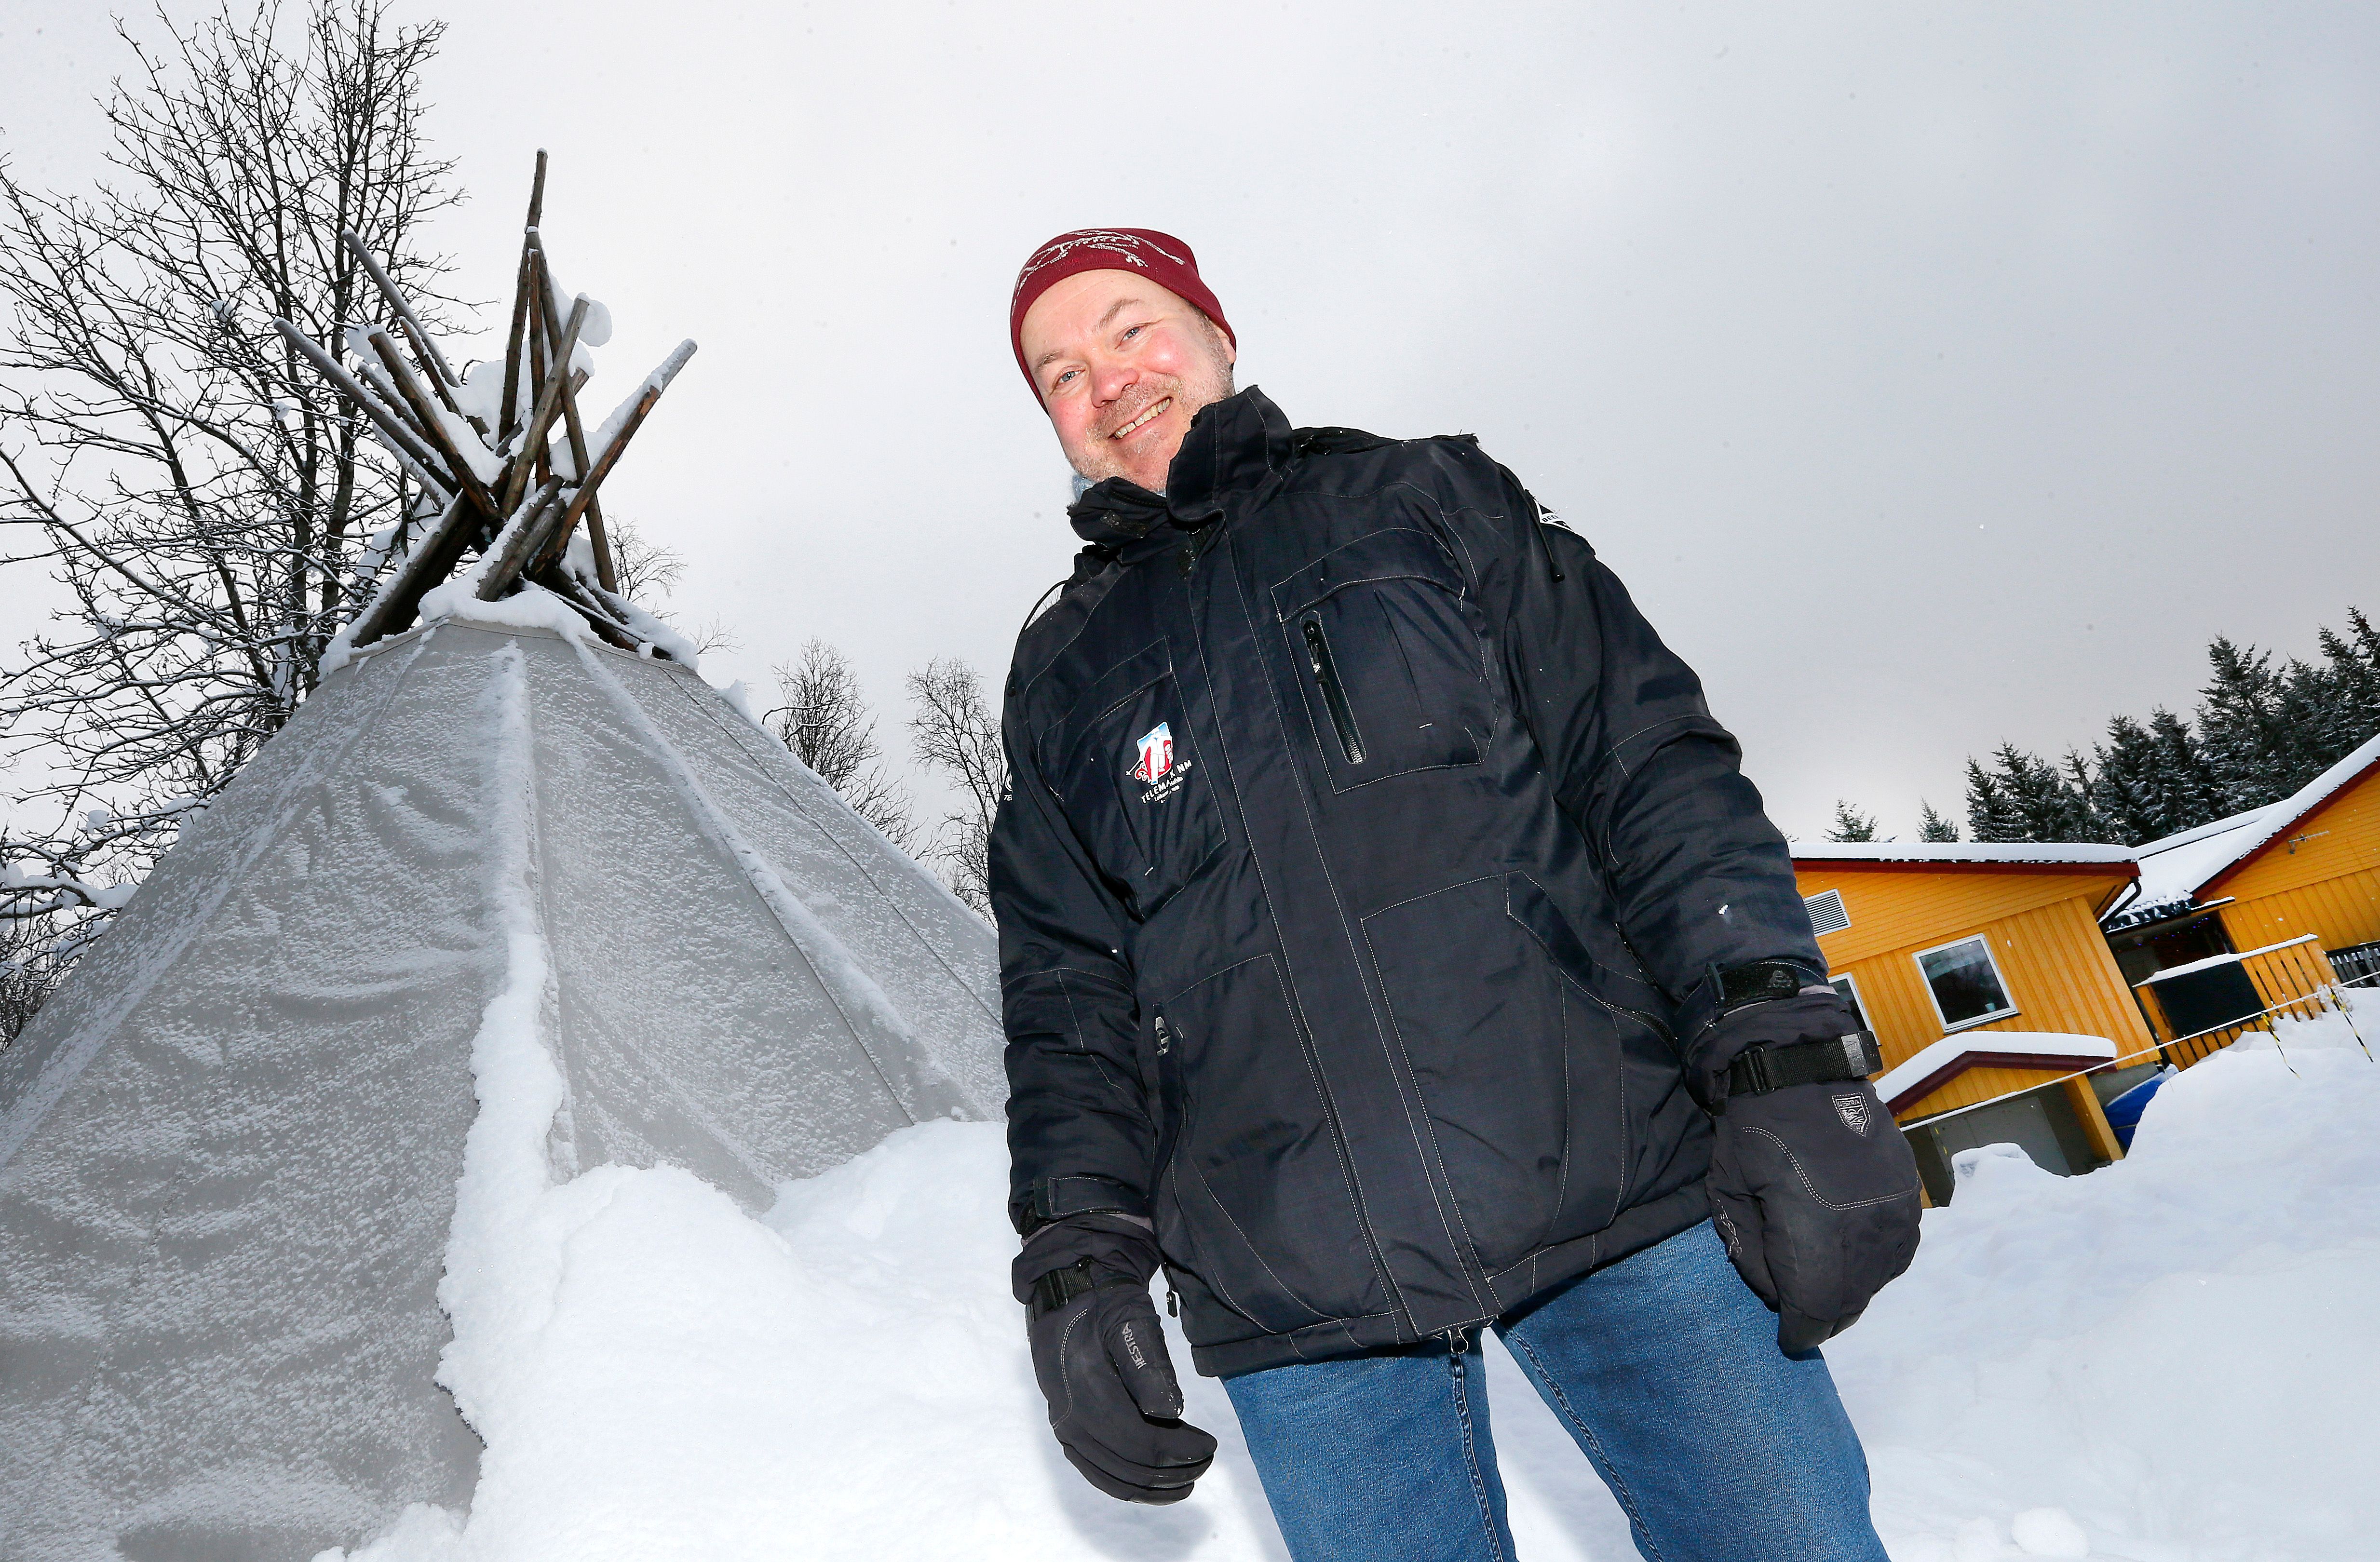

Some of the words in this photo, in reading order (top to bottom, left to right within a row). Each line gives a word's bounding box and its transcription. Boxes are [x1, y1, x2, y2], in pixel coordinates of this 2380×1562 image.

[1141, 769, 1176, 804] TELEMAK
[1176, 759, 1192, 773] NM
[1122, 1322, 1147, 1370] HESTRA
